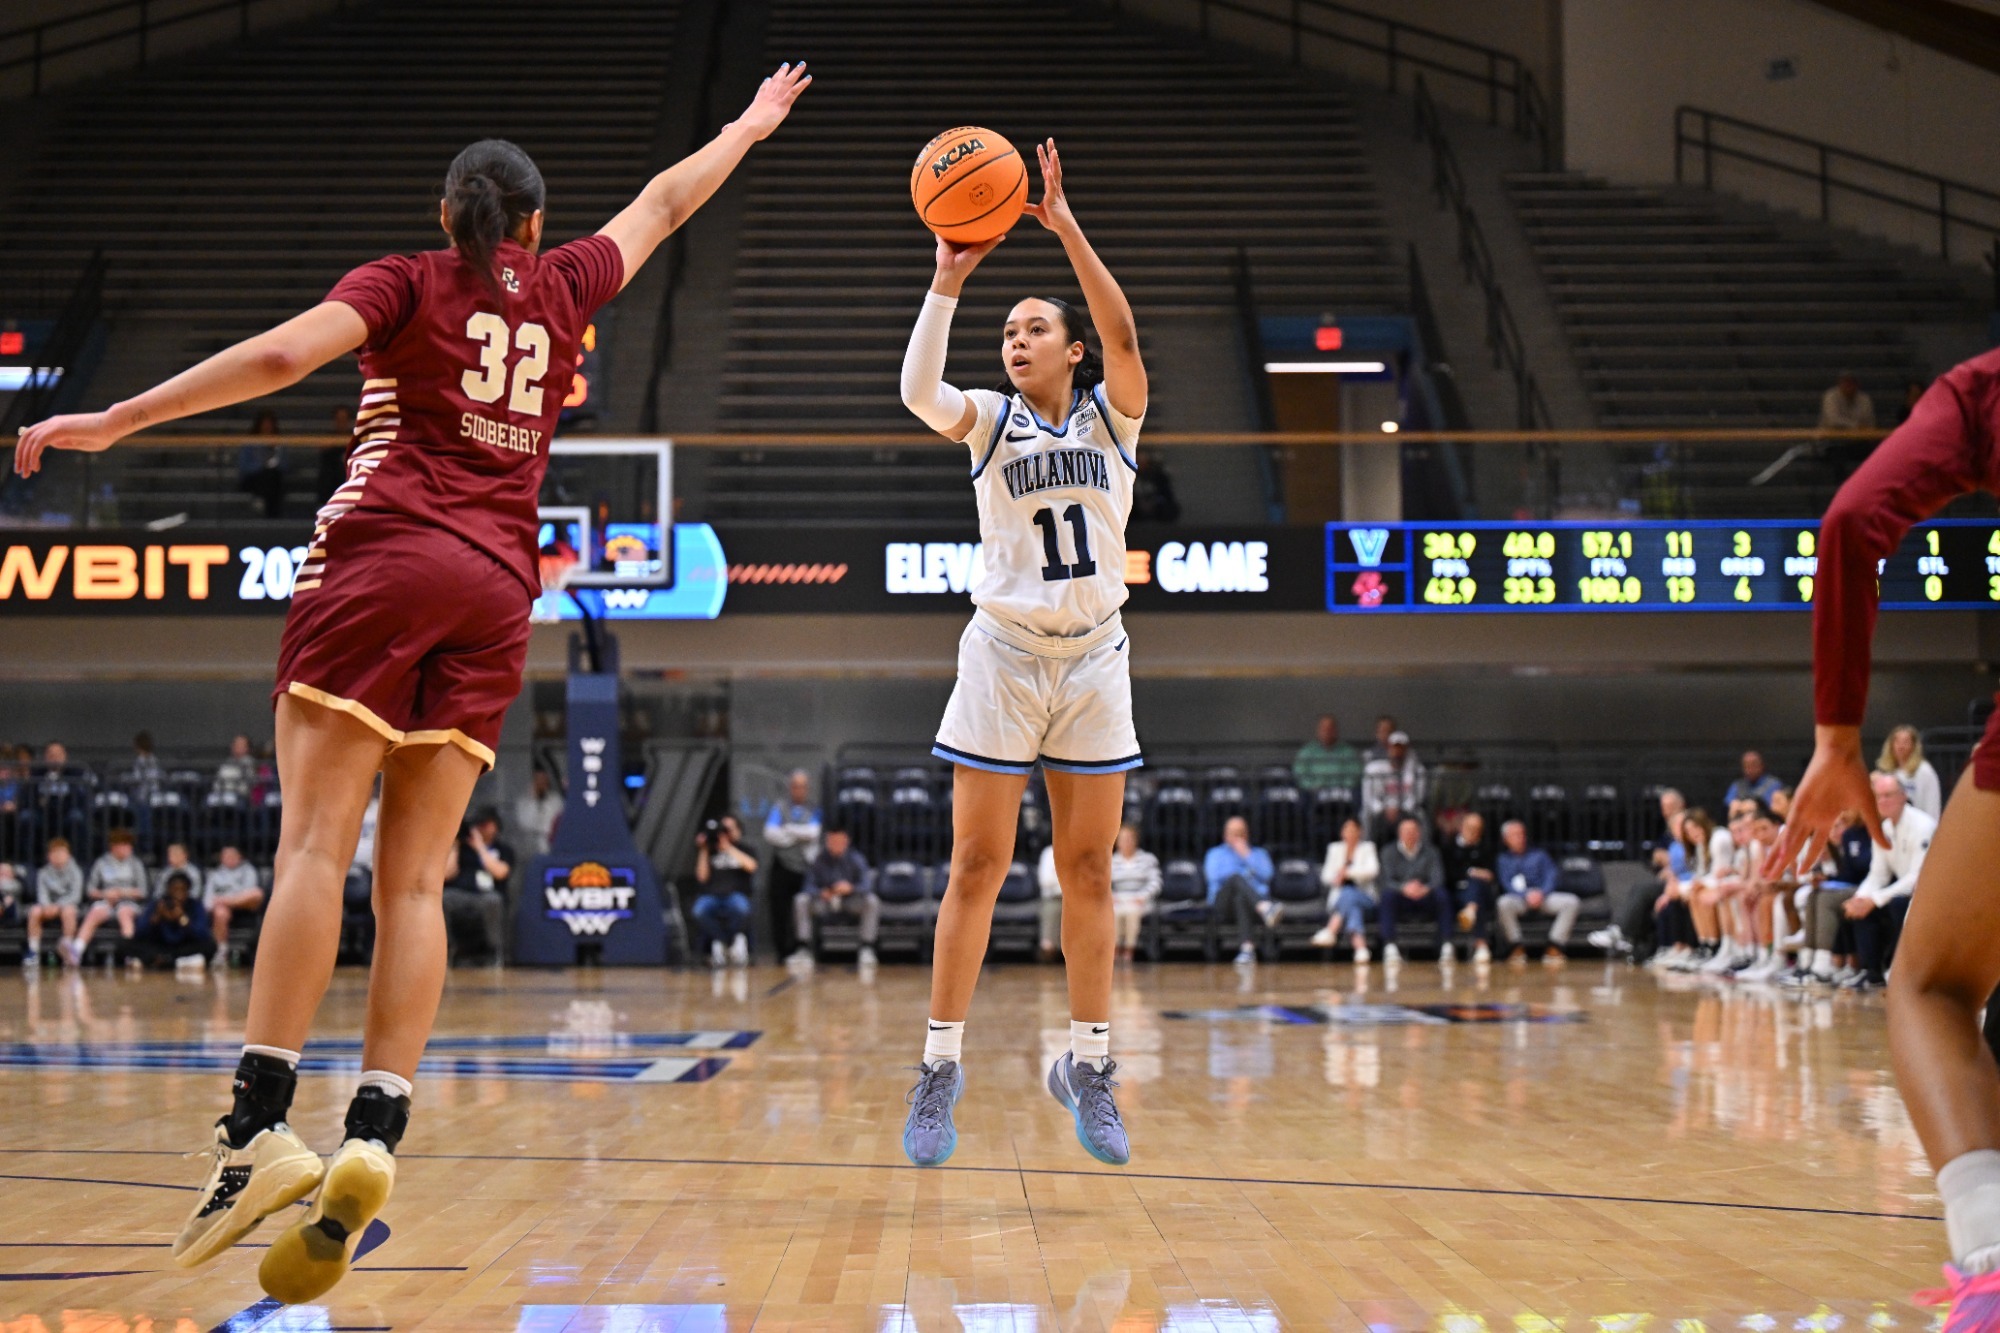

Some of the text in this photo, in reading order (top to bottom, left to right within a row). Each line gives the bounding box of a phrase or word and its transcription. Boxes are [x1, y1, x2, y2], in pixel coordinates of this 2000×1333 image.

[932, 138, 986, 179] NCAA
[461, 311, 550, 417] 32
[460, 412, 542, 455] SIDBERRY
[1002, 448, 1110, 501] VILLANOVA
[1033, 504, 1096, 581] 11
[1582, 531, 1632, 558] 57.1
[1665, 531, 1693, 557] 11
[1733, 531, 1751, 557] 3
[1926, 530, 1939, 556] 1
[0, 545, 230, 600] WBIT
[1156, 541, 1269, 593] GAME
[1918, 556, 1949, 575] STL
[1578, 577, 1641, 604] 100.0
[1666, 576, 1695, 603] 13
[1925, 575, 1942, 601] 0
[545, 886, 636, 910] WBIT
